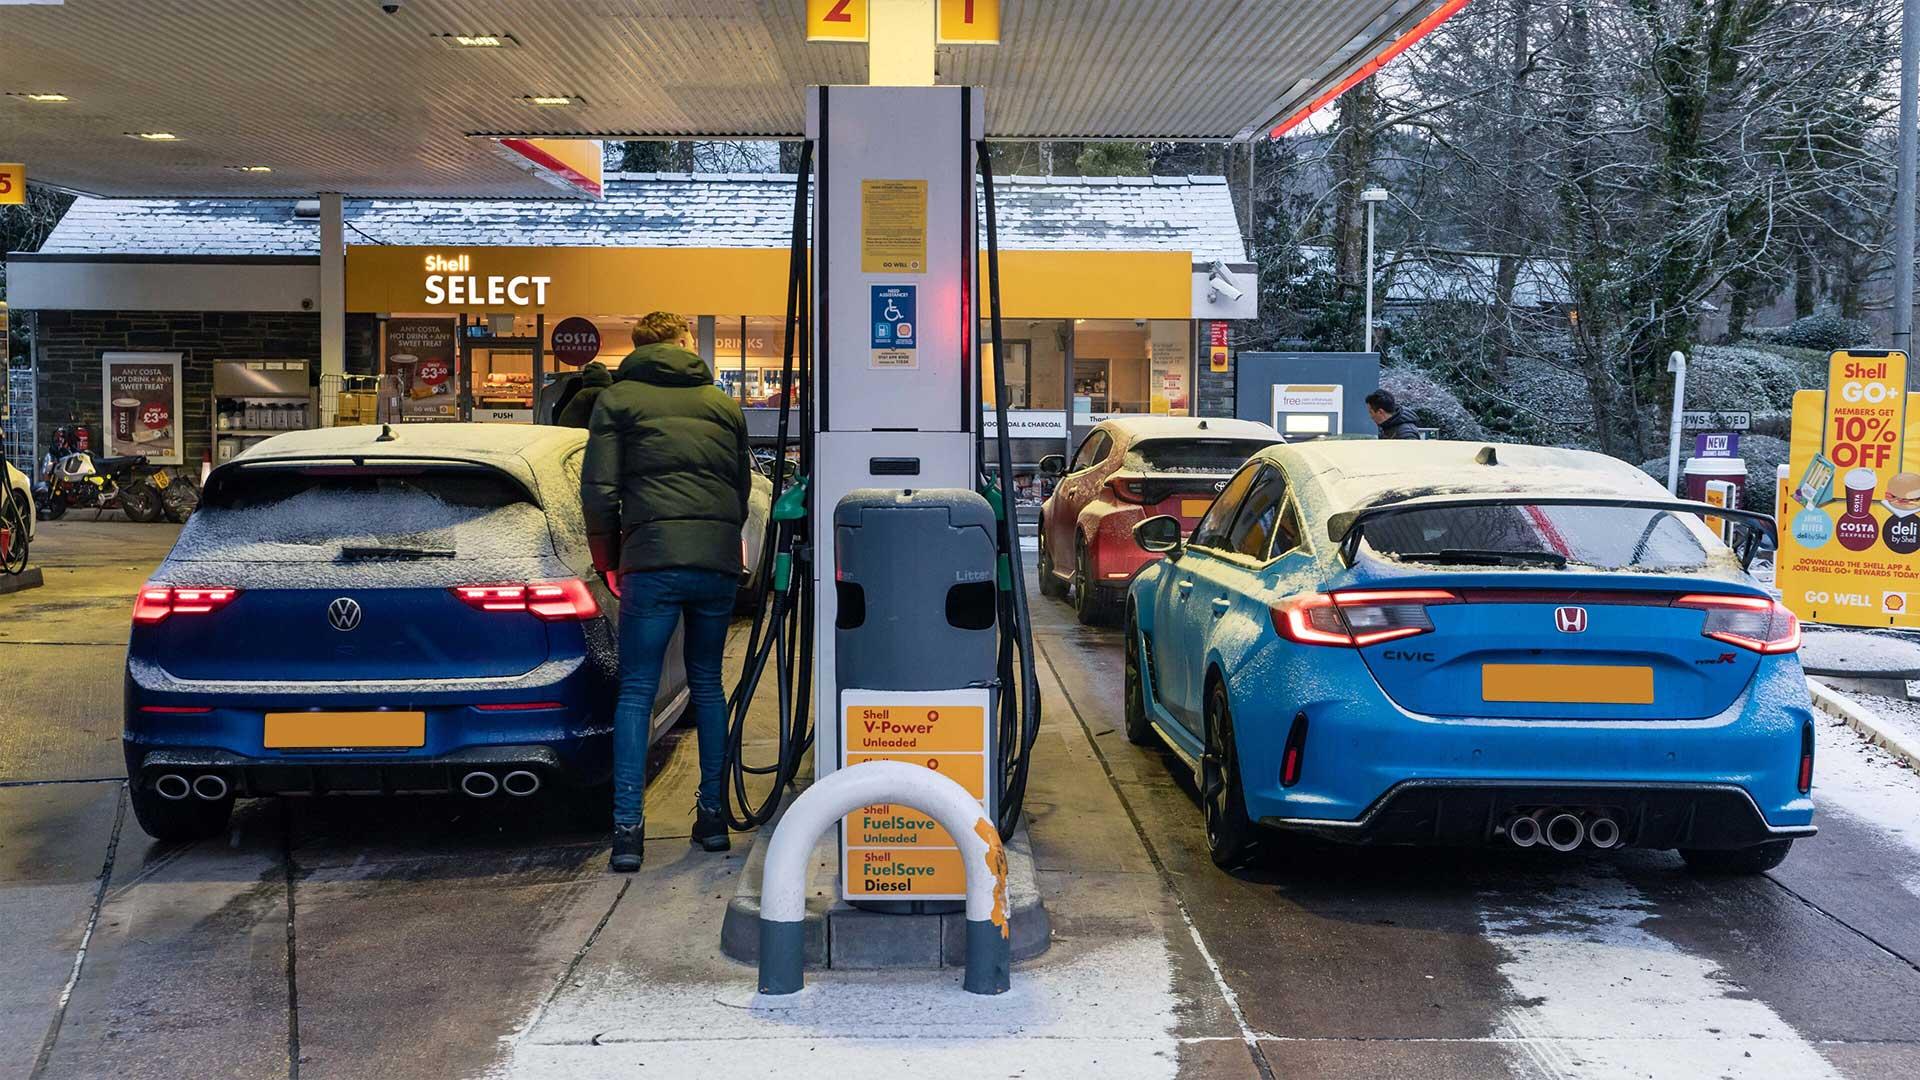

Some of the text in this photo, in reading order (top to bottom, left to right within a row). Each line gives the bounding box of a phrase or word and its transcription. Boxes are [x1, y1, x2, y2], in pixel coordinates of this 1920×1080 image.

[0, 173, 11, 193] 5
[425, 255, 469, 271] Shell
[425, 275, 551, 305] SELECT
[555, 333, 597, 344] COSTA
[1844, 363, 1887, 379] Shell
[1842, 382, 1898, 403] GO+
[1283, 397, 1300, 405] free
[1834, 408, 1894, 417] MEMBERS GET
[1834, 417, 1896, 443] 10%
[1708, 437, 1726, 448] NEW
[1832, 443, 1891, 468] OFF
[1840, 523, 1874, 532] COSTA
[1891, 521, 1917, 535] deli
[1891, 535, 1917, 544] by Shell
[1800, 558, 1845, 567] DOWNLOAD
[956, 571, 989, 581] Litter
[1854, 569, 1891, 577] REWARDS
[1894, 571, 1919, 579] TODAY
[1805, 591, 1872, 607] GO WELL
[1383, 651, 1435, 662] CIVIC
[863, 710, 889, 719] Shell
[864, 721, 933, 734] V-Power
[863, 738, 917, 747] Unleaded
[864, 805, 889, 814] Shell
[863, 817, 935, 830] FuelSave
[863, 834, 917, 843] Unleaded
[864, 853, 890, 861] Shell
[863, 863, 935, 876] FuelSave
[864, 879, 911, 891] Diesel
